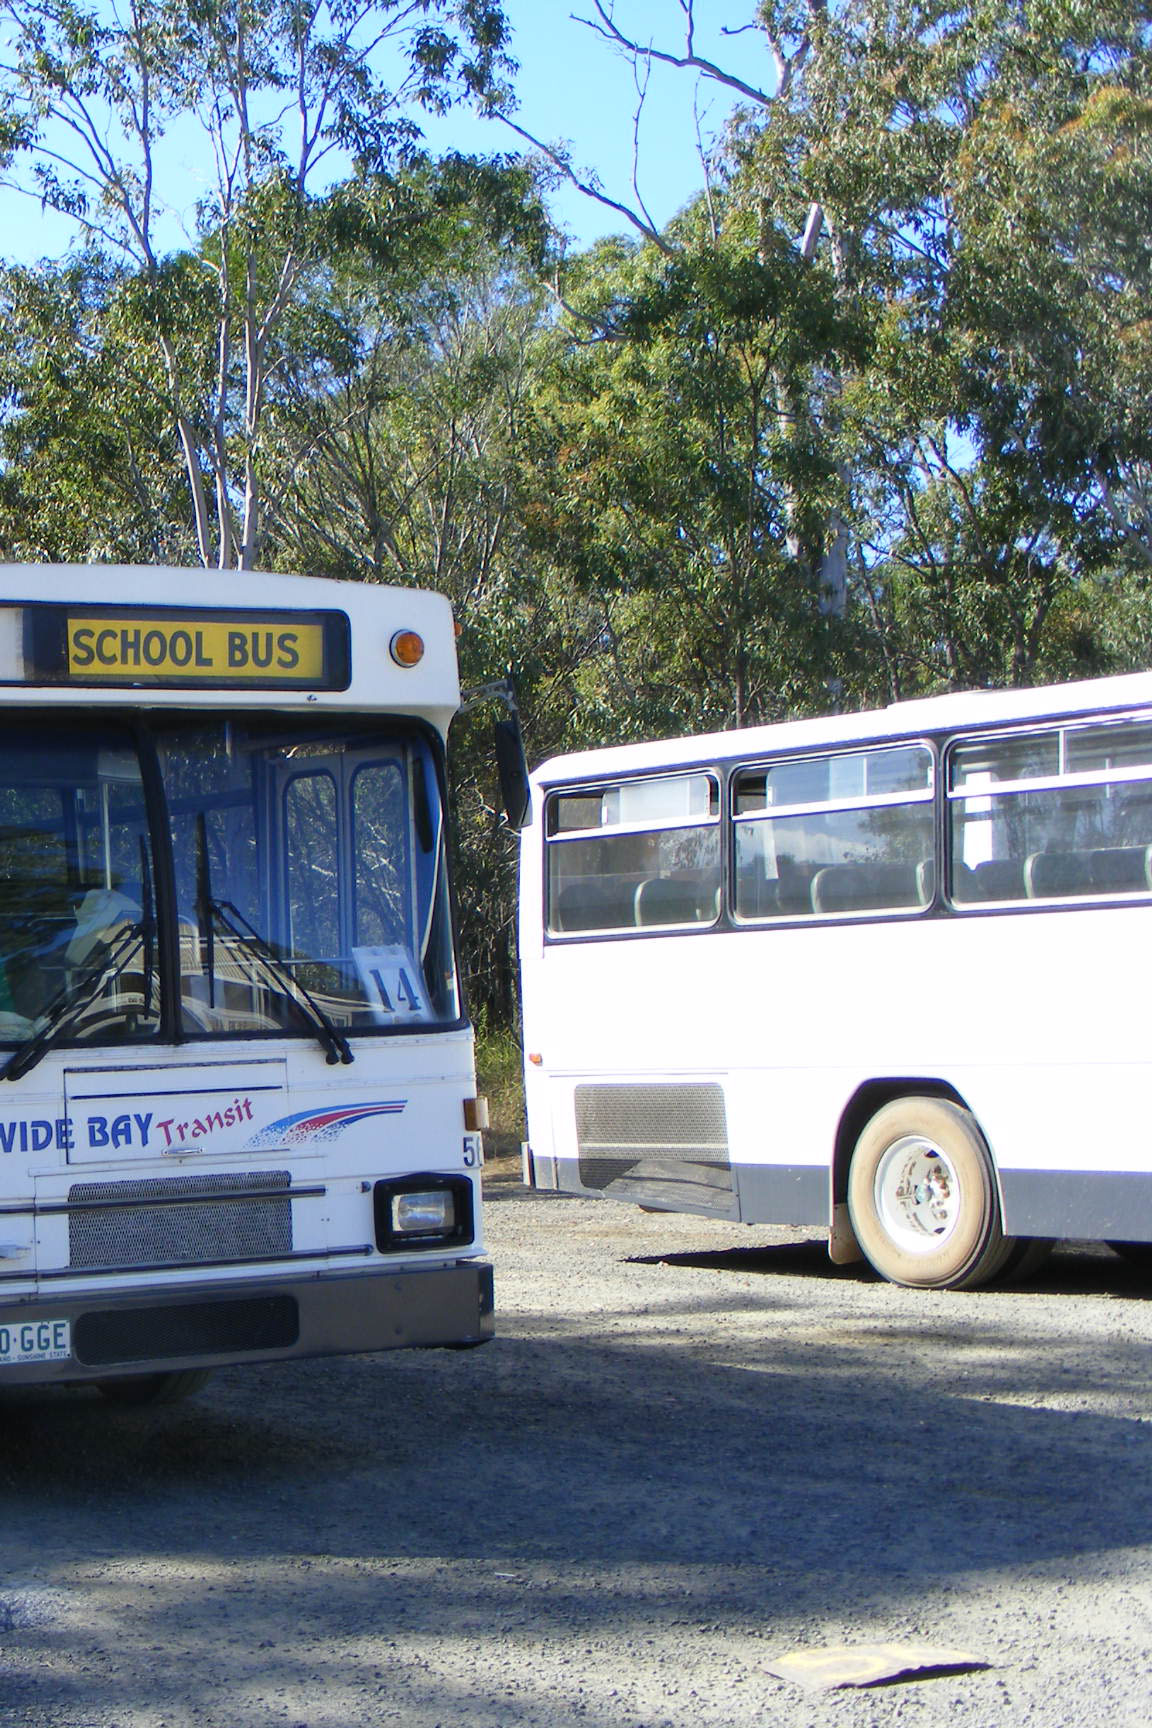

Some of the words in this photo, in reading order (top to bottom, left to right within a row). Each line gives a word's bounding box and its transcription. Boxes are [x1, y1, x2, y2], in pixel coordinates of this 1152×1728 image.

[72, 628, 213, 666] SCHOOL
[227, 631, 299, 669] BUS
[369, 967, 422, 1013] 14
[87, 1112, 153, 1149] BAY
[155, 1097, 254, 1146] Transit
